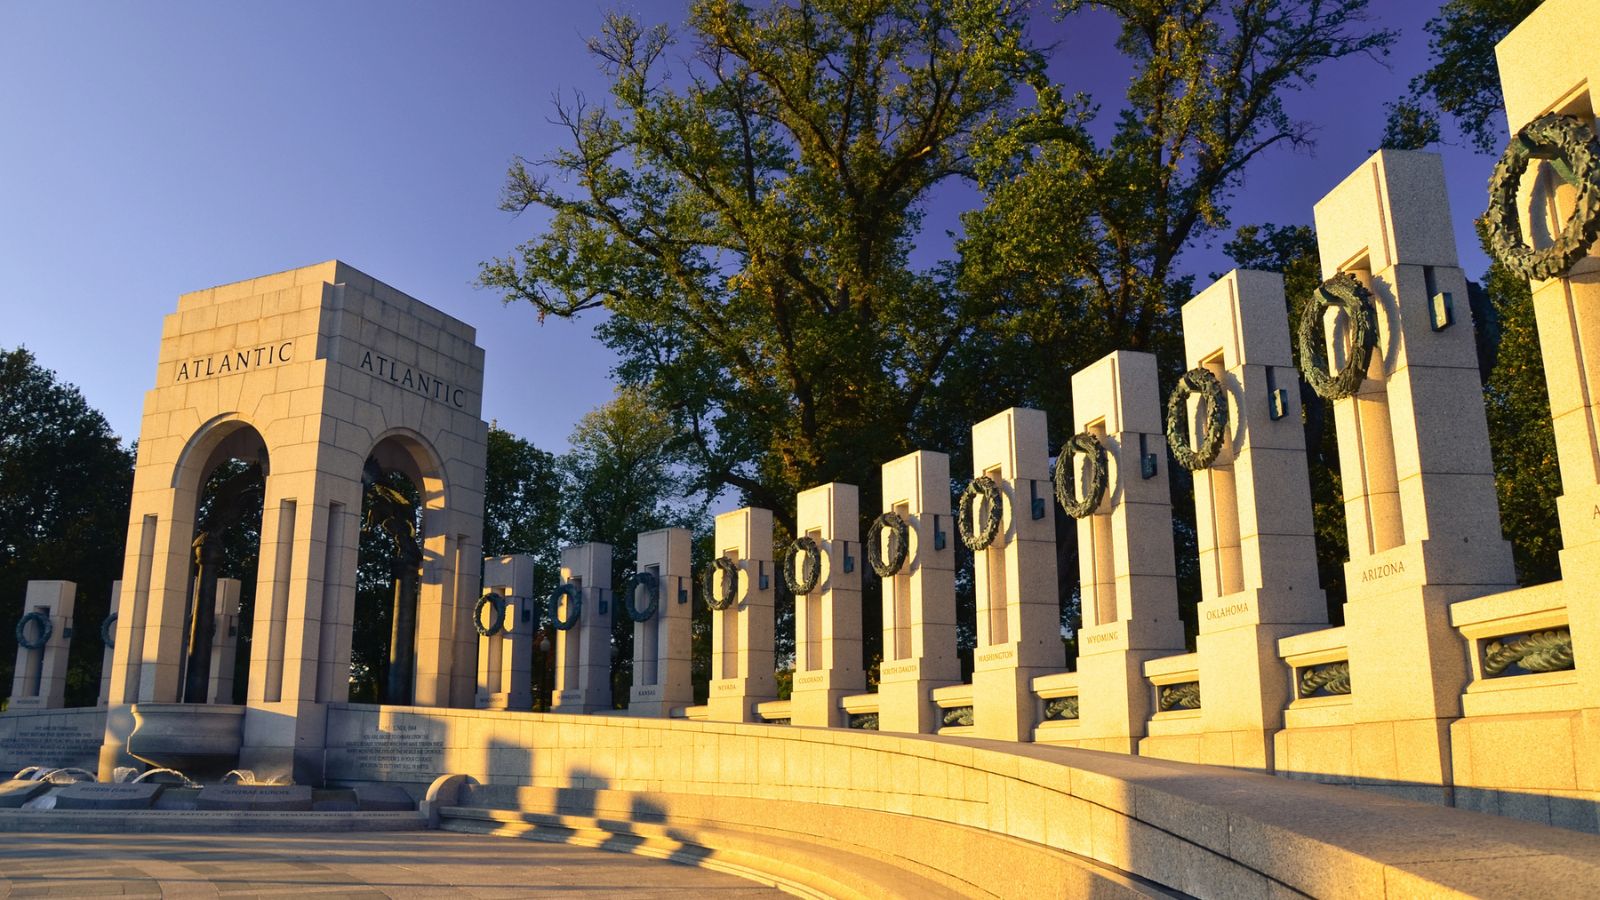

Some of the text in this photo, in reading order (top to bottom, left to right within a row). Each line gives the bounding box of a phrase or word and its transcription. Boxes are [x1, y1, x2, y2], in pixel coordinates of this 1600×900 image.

[176, 341, 293, 382] ATLANTIC
[360, 351, 464, 408] ATLANTIC
[1361, 561, 1406, 583] ARIZONA
[1205, 601, 1250, 621] OKLAHOMA
[1086, 630, 1119, 645] WYOMING
[977, 650, 1014, 663] WASHINGTON
[882, 667, 898, 676] SOUTH
[798, 676, 824, 685] COLORADO
